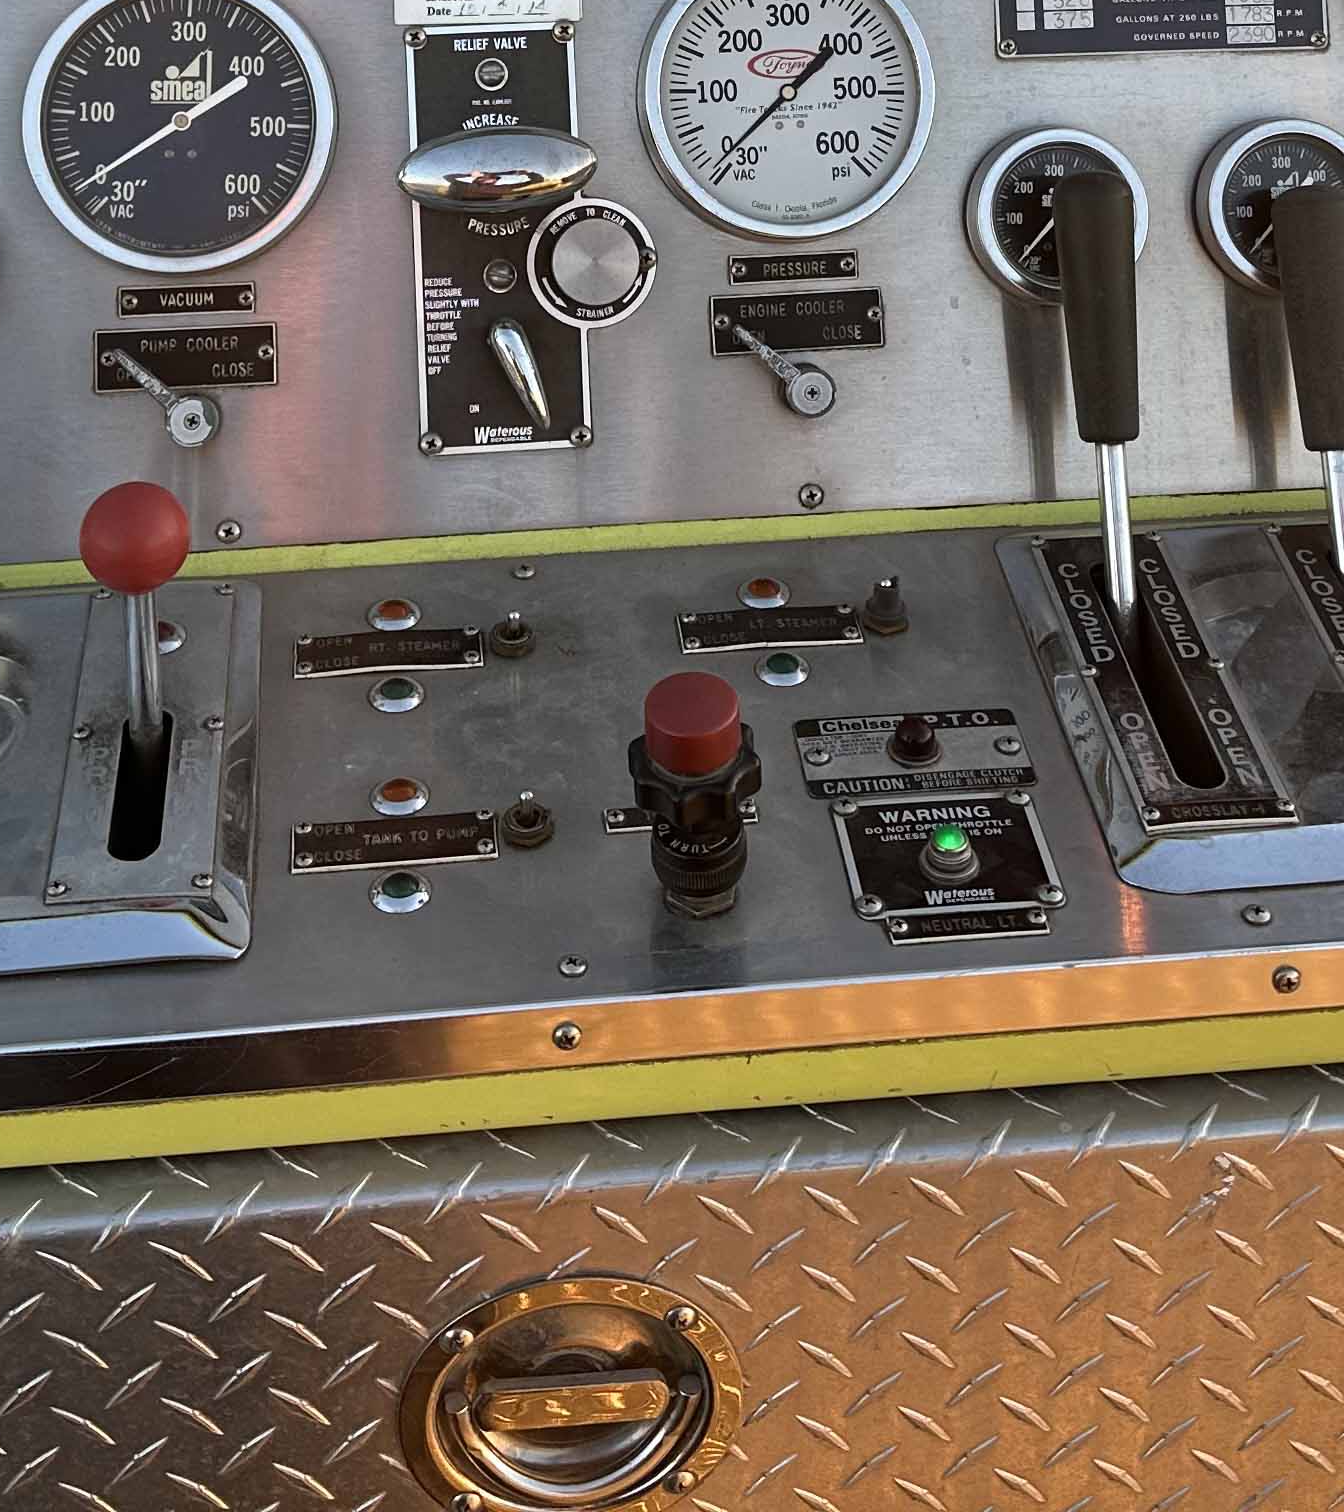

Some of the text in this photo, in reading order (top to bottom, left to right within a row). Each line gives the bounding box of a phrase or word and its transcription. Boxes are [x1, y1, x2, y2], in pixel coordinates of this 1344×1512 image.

[427, 5, 452, 17] Date
[765, 2, 811, 28] 300
[1115, 6, 1275, 24] GALLONS LBS 1783
[170, 21, 207, 42] 300
[1133, 32, 1186, 41] GOVERNED
[1189, 31, 1220, 40] SPEED
[453, 36, 528, 52] RELIEF VALVE
[717, 28, 763, 54] 200
[818, 32, 864, 57] 400
[104, 45, 141, 68] 200
[228, 55, 265, 77] 400
[697, 78, 738, 104] 100
[833, 75, 878, 100] 500
[79, 101, 115, 123] 100
[249, 116, 286, 137] 500
[721, 135, 733, 155] 0
[816, 130, 860, 155] 600
[1044, 164, 1064, 177] 300
[1271, 156, 1291, 169] 300
[733, 168, 756, 181] VAC
[831, 164, 851, 181] psi
[1242, 174, 1262, 187] 200
[224, 174, 261, 195] 600
[1014, 181, 1034, 194] 200
[109, 203, 134, 219] VAC
[227, 201, 250, 222] psi
[586, 207, 596, 217] TO
[1006, 212, 1023, 225] 100
[1236, 205, 1253, 218] 100
[467, 216, 531, 237] PRESSURE
[763, 261, 828, 277] PRESSURE
[424, 277, 453, 287] REDUCE
[159, 292, 214, 308] VACUUM
[424, 288, 462, 297] PRESSURE
[424, 298, 480, 309] SLIGHTLY WITH
[739, 299, 846, 319] ENGINE COOLER
[425, 310, 462, 320] THROTTLE
[426, 322, 455, 331] BEFORE
[823, 324, 863, 340] CLOSE
[140, 335, 240, 353] PUMP COOLER
[426, 332, 458, 342] TURNING
[427, 343, 452, 354] RELIEF
[427, 355, 451, 365] VALVE
[211, 362, 256, 379] CLOSE
[469, 404, 480, 414] ON
[474, 425, 534, 445] Waterous
[1057, 563, 1116, 663] CLOSED
[1139, 558, 1201, 659] CLOSED
[1119, 712, 1172, 791] OPEN
[1208, 708, 1263, 787] OPEN
[913, 767, 1024, 783] DISENGAGE CLUTCH
[921, 775, 1019, 789] BEFORE SHIFTING
[823, 776, 911, 795] CAUTION:
[879, 805, 992, 824] WARNING
[864, 818, 1014, 835] DO NOT THROTTLE
[362, 831, 403, 846] TANK
[880, 832, 927, 842] UNLESS
[669, 839, 710, 855] TURN
[924, 888, 995, 906] Waterous
[921, 918, 993, 933] NEUTRAL
